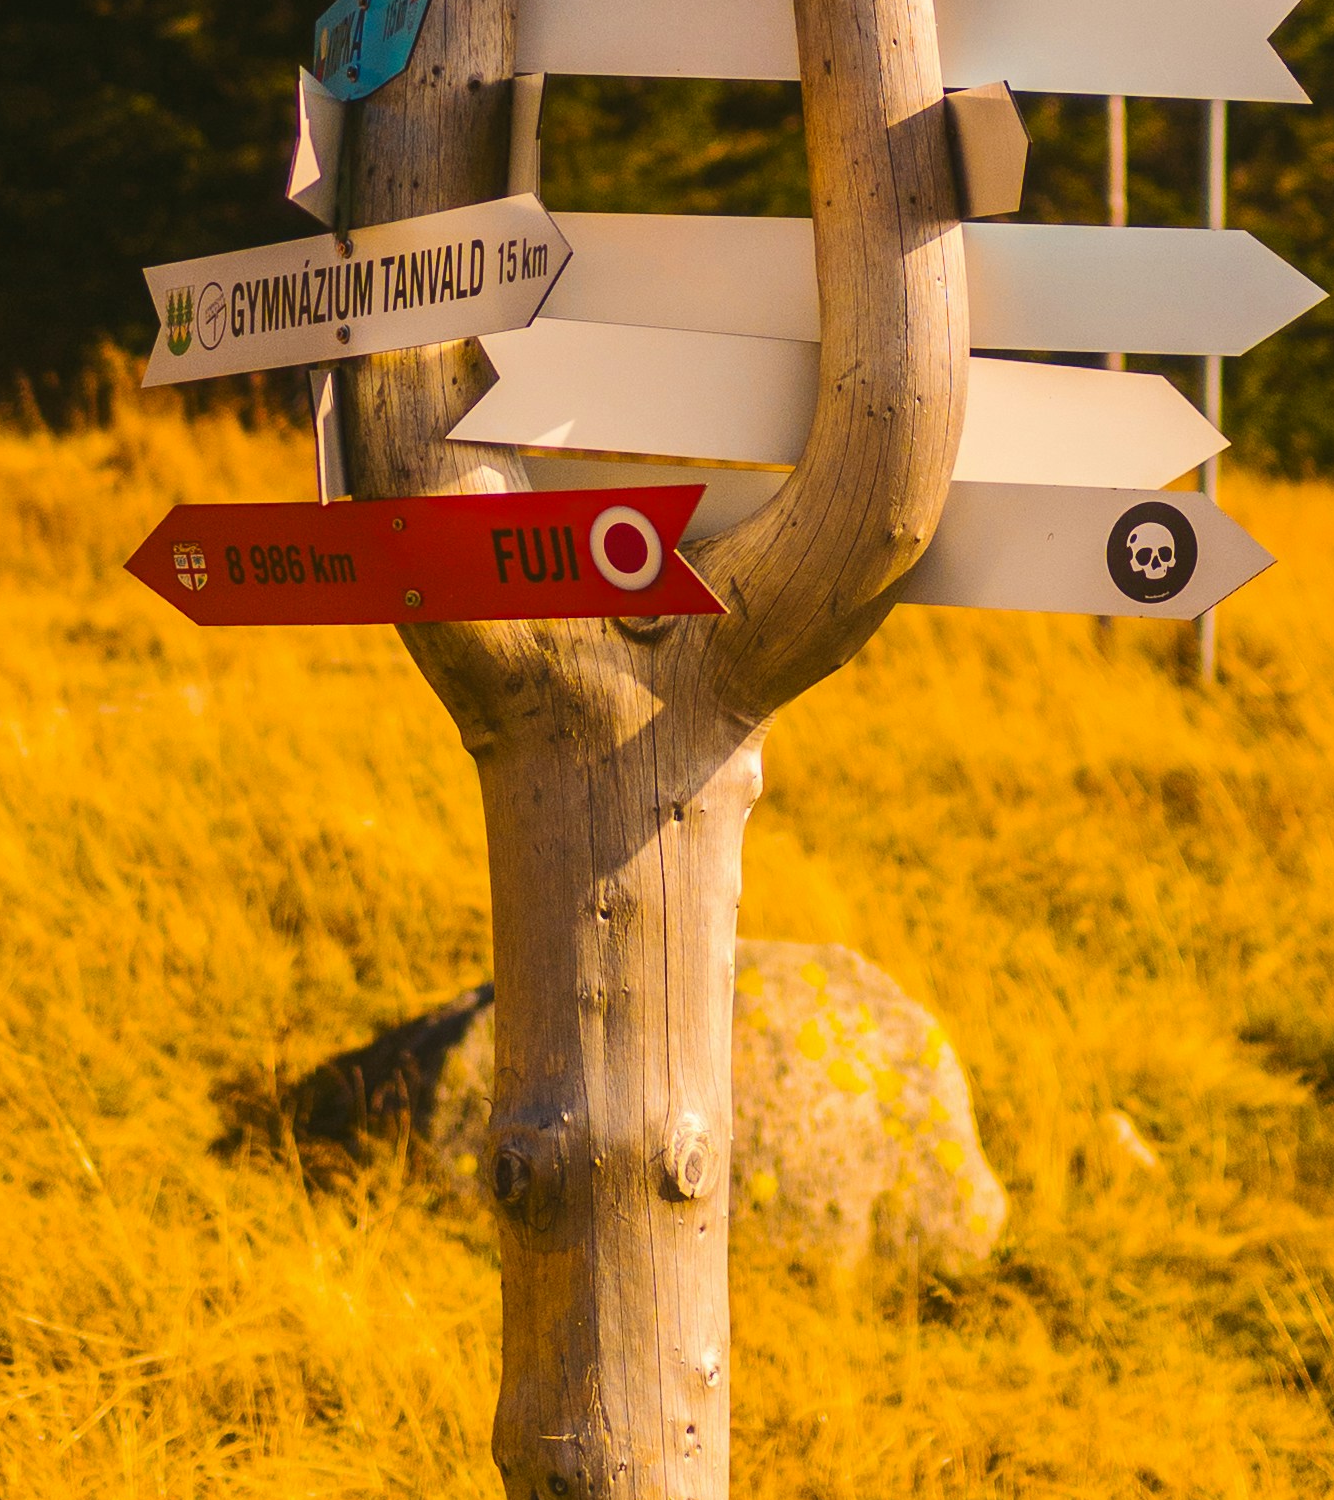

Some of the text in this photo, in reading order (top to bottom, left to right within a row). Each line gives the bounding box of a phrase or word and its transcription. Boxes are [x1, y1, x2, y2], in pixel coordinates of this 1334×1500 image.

[230, 259, 375, 338] GYMNÁZIUM
[381, 239, 485, 312] TANVALD
[498, 239, 518, 285] 15
[522, 237, 549, 281] km
[225, 526, 581, 585] 8 986 km FUJI
